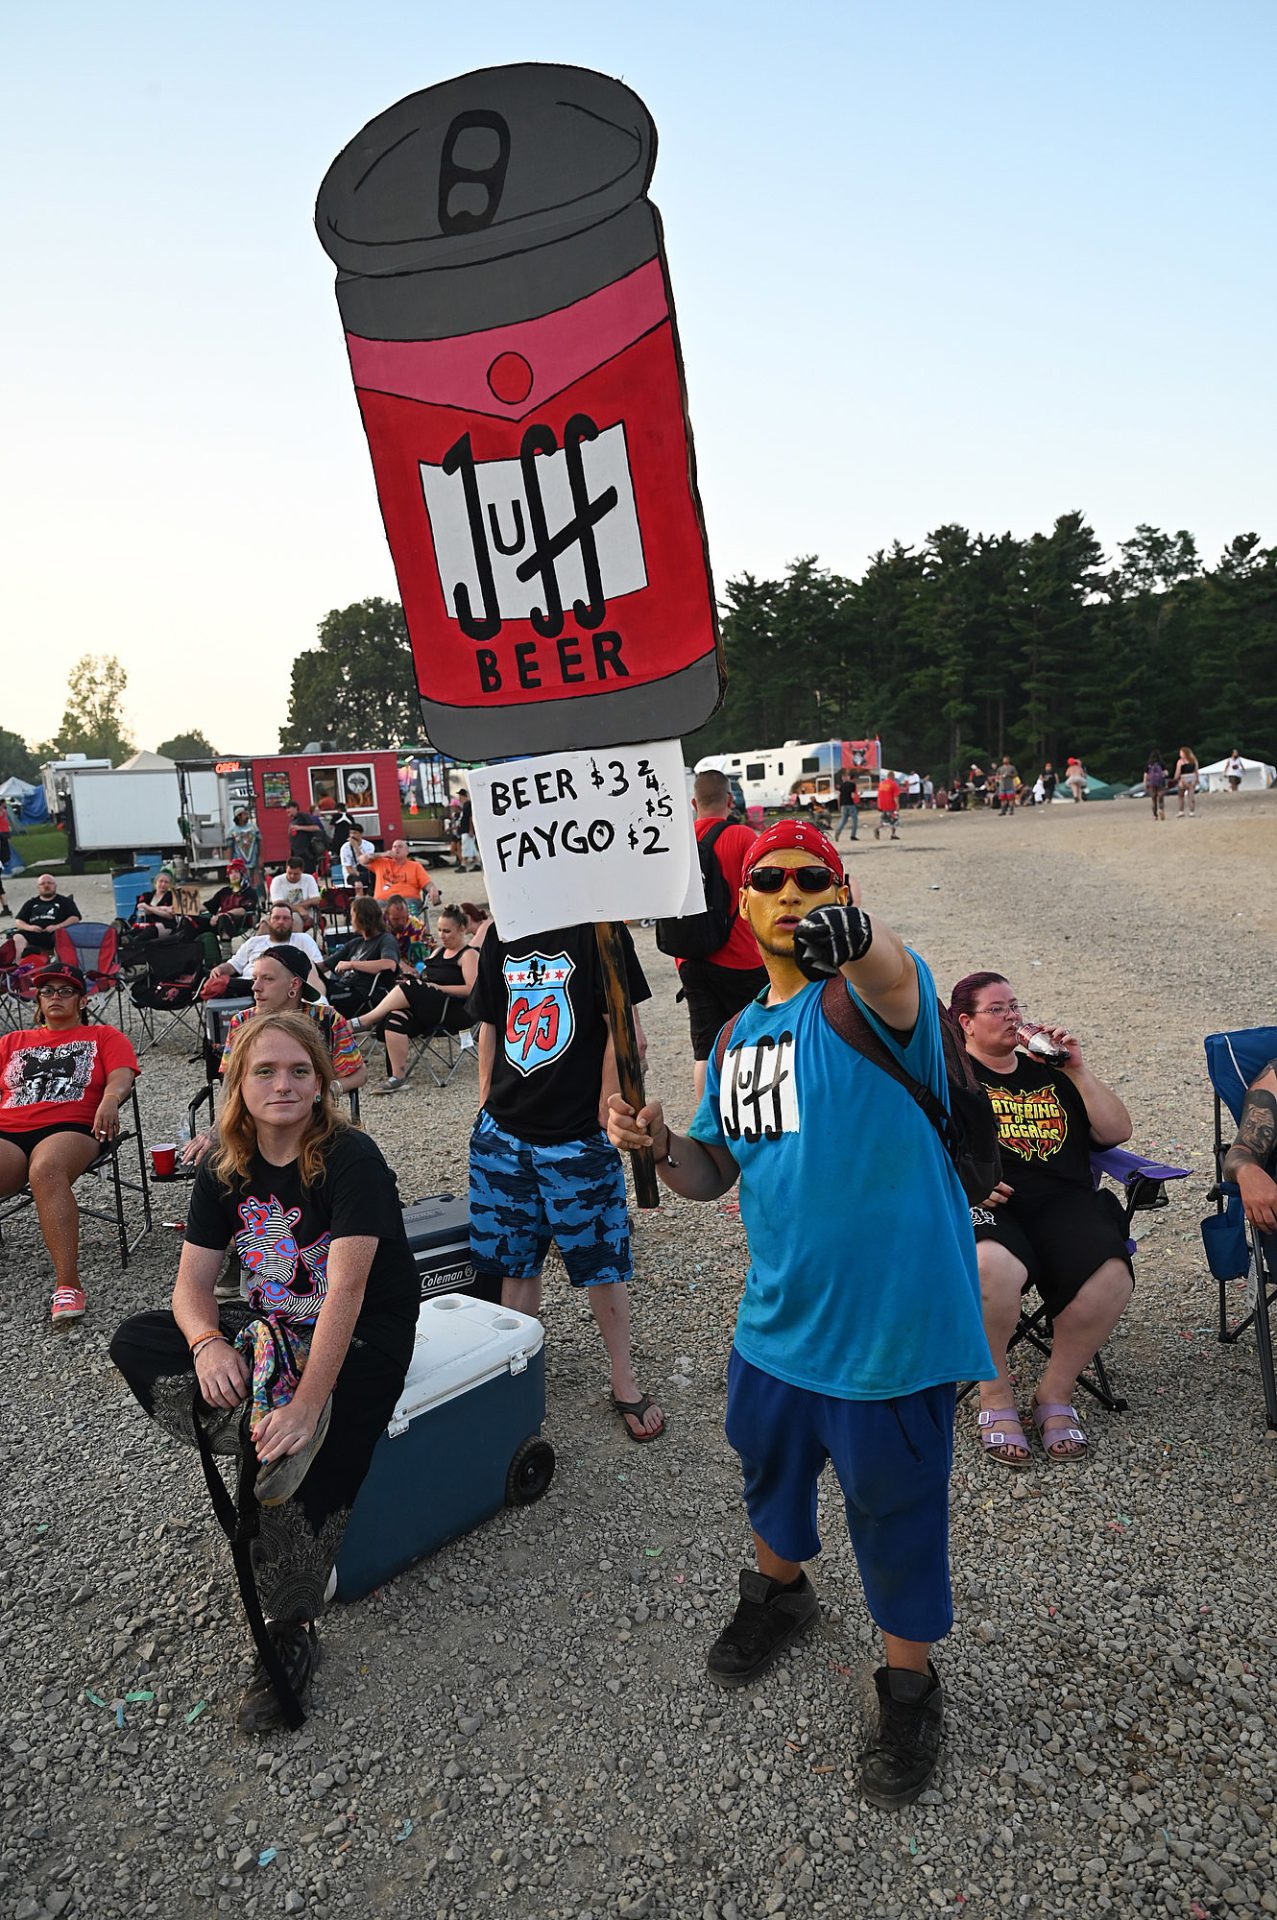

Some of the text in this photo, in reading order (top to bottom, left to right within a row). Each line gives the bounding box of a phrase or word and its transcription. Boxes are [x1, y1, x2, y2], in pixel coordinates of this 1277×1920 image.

[476, 631, 629, 693] BEER
[215, 762, 241, 774] OPEN
[491, 757, 629, 816] BEER $3
[645, 794, 673, 818] $5
[496, 819, 670, 873] FAYGO $2
[991, 1099, 1060, 1119] ATHERING
[997, 1124, 1061, 1142] UGGALOS
[421, 1269, 463, 1289] Coleman
